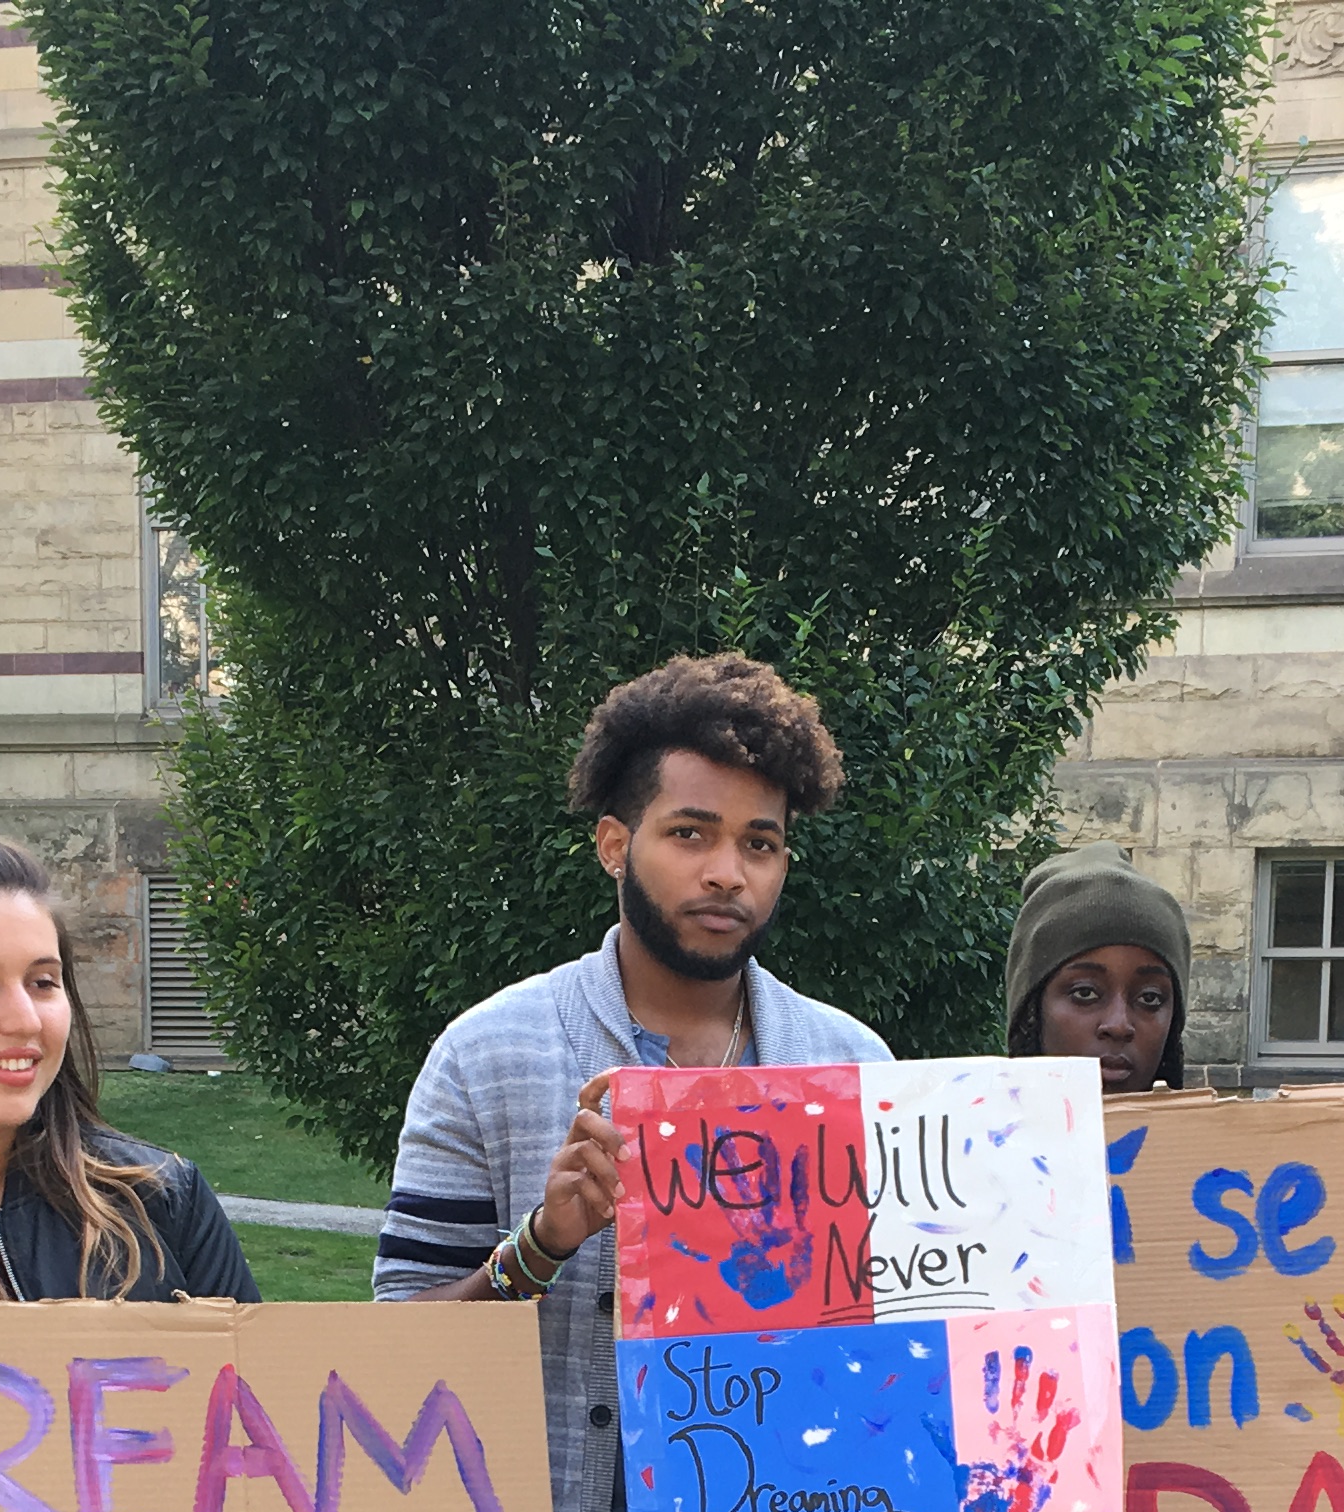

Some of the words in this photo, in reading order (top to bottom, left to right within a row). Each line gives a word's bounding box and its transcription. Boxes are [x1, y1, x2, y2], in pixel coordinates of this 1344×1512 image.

[816, 1115, 967, 1212] Will
[1110, 1126, 1149, 1265] í
[1190, 1161, 1337, 1280] se
[823, 1214, 987, 1306] Never
[663, 1341, 782, 1425] Stop
[1121, 1323, 1260, 1431] on
